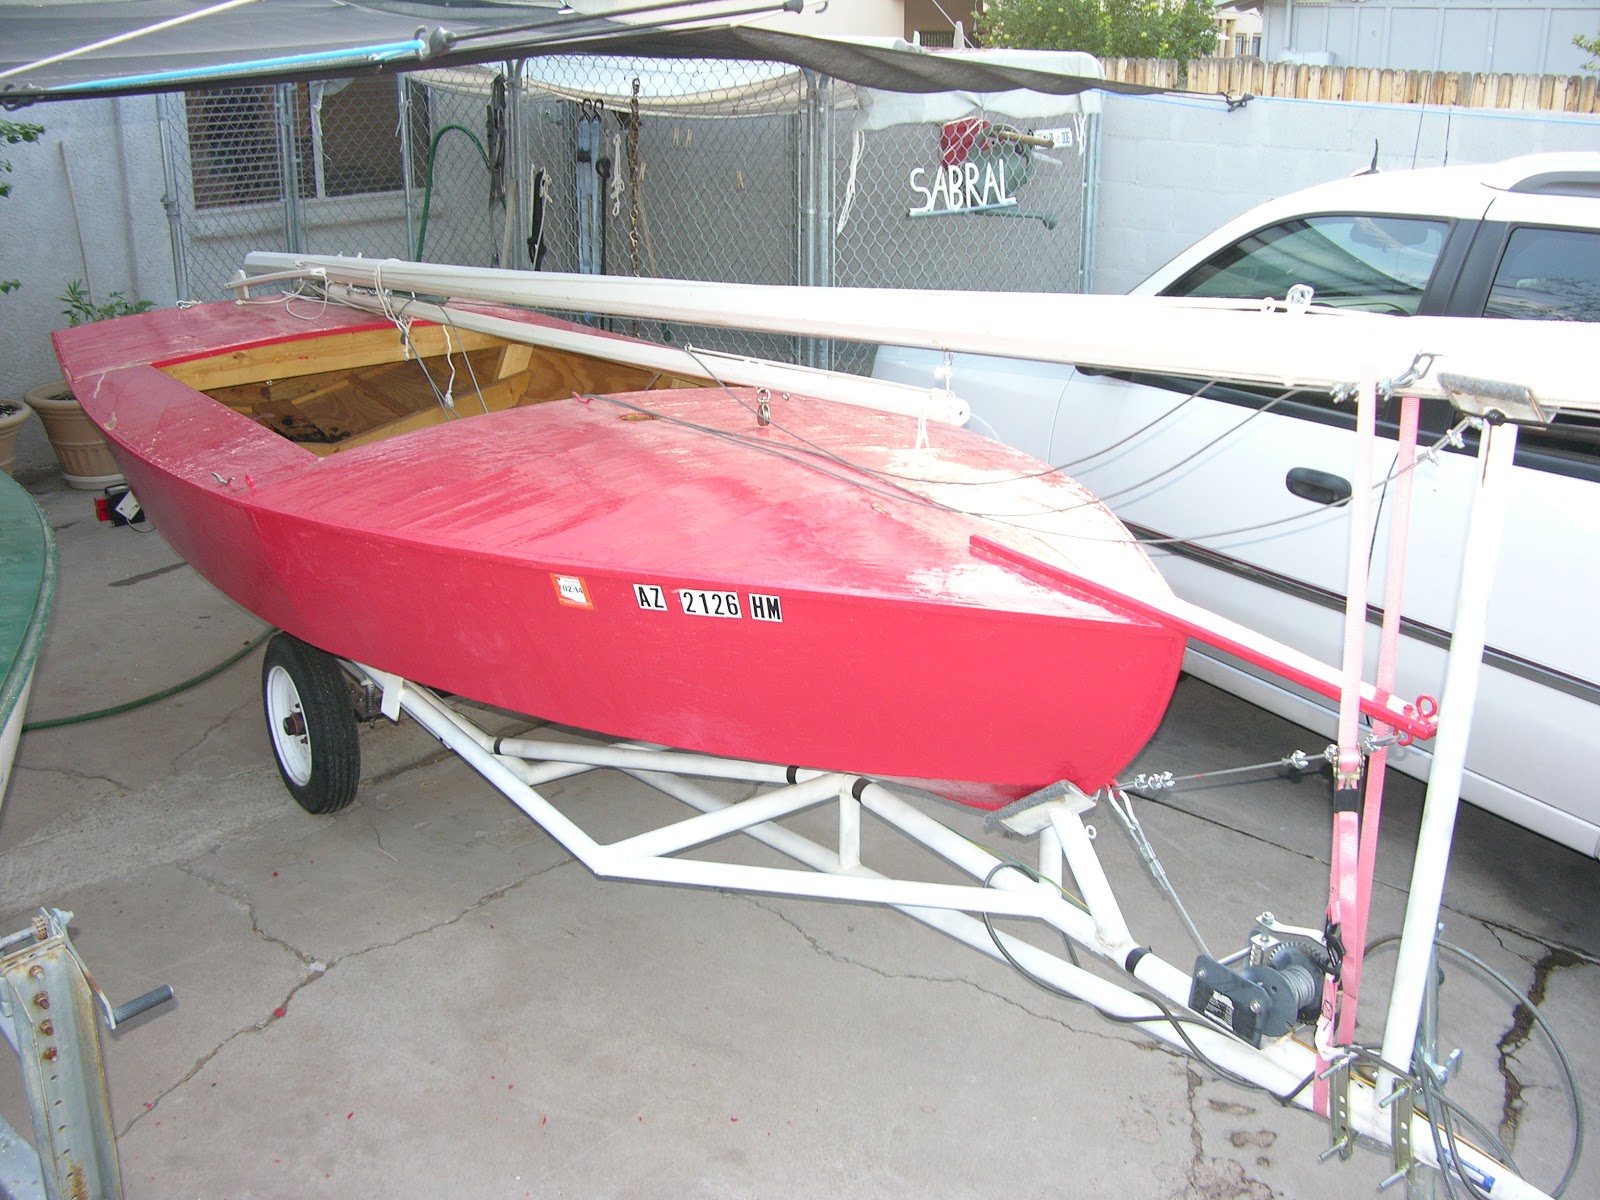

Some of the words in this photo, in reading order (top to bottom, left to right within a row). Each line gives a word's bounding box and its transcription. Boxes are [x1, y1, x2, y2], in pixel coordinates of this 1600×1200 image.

[909, 158, 1017, 213] SABRAL
[637, 586, 665, 609] AZ
[682, 591, 739, 616] 2126
[752, 595, 782, 620] HM
